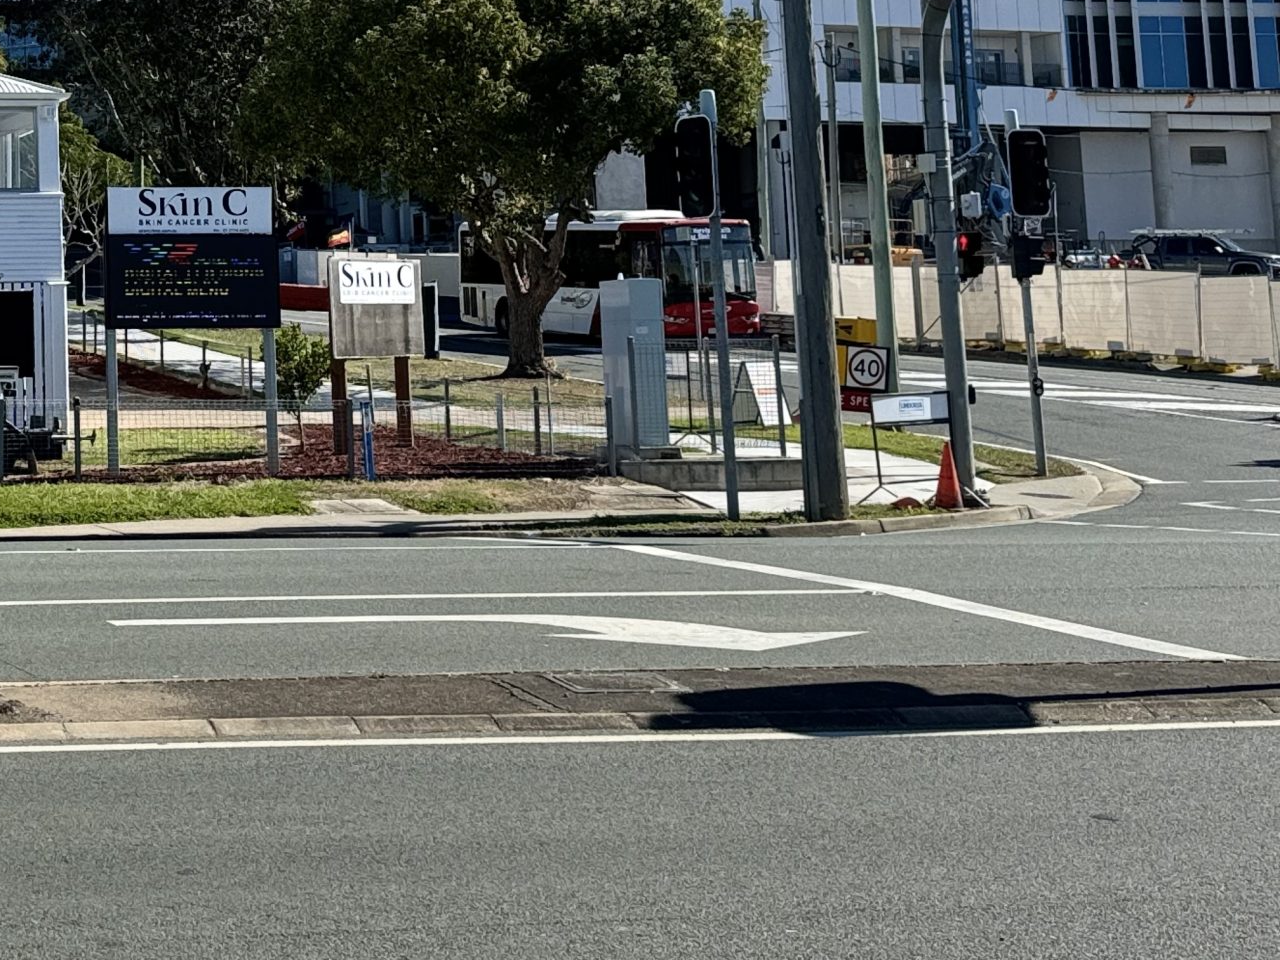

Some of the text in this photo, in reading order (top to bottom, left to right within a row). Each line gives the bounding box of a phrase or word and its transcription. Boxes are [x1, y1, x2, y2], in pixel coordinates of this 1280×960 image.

[138, 189, 248, 216] Skin C
[341, 263, 412, 288] Skin C
[854, 359, 880, 377] 40
[850, 395, 869, 407] SPE
